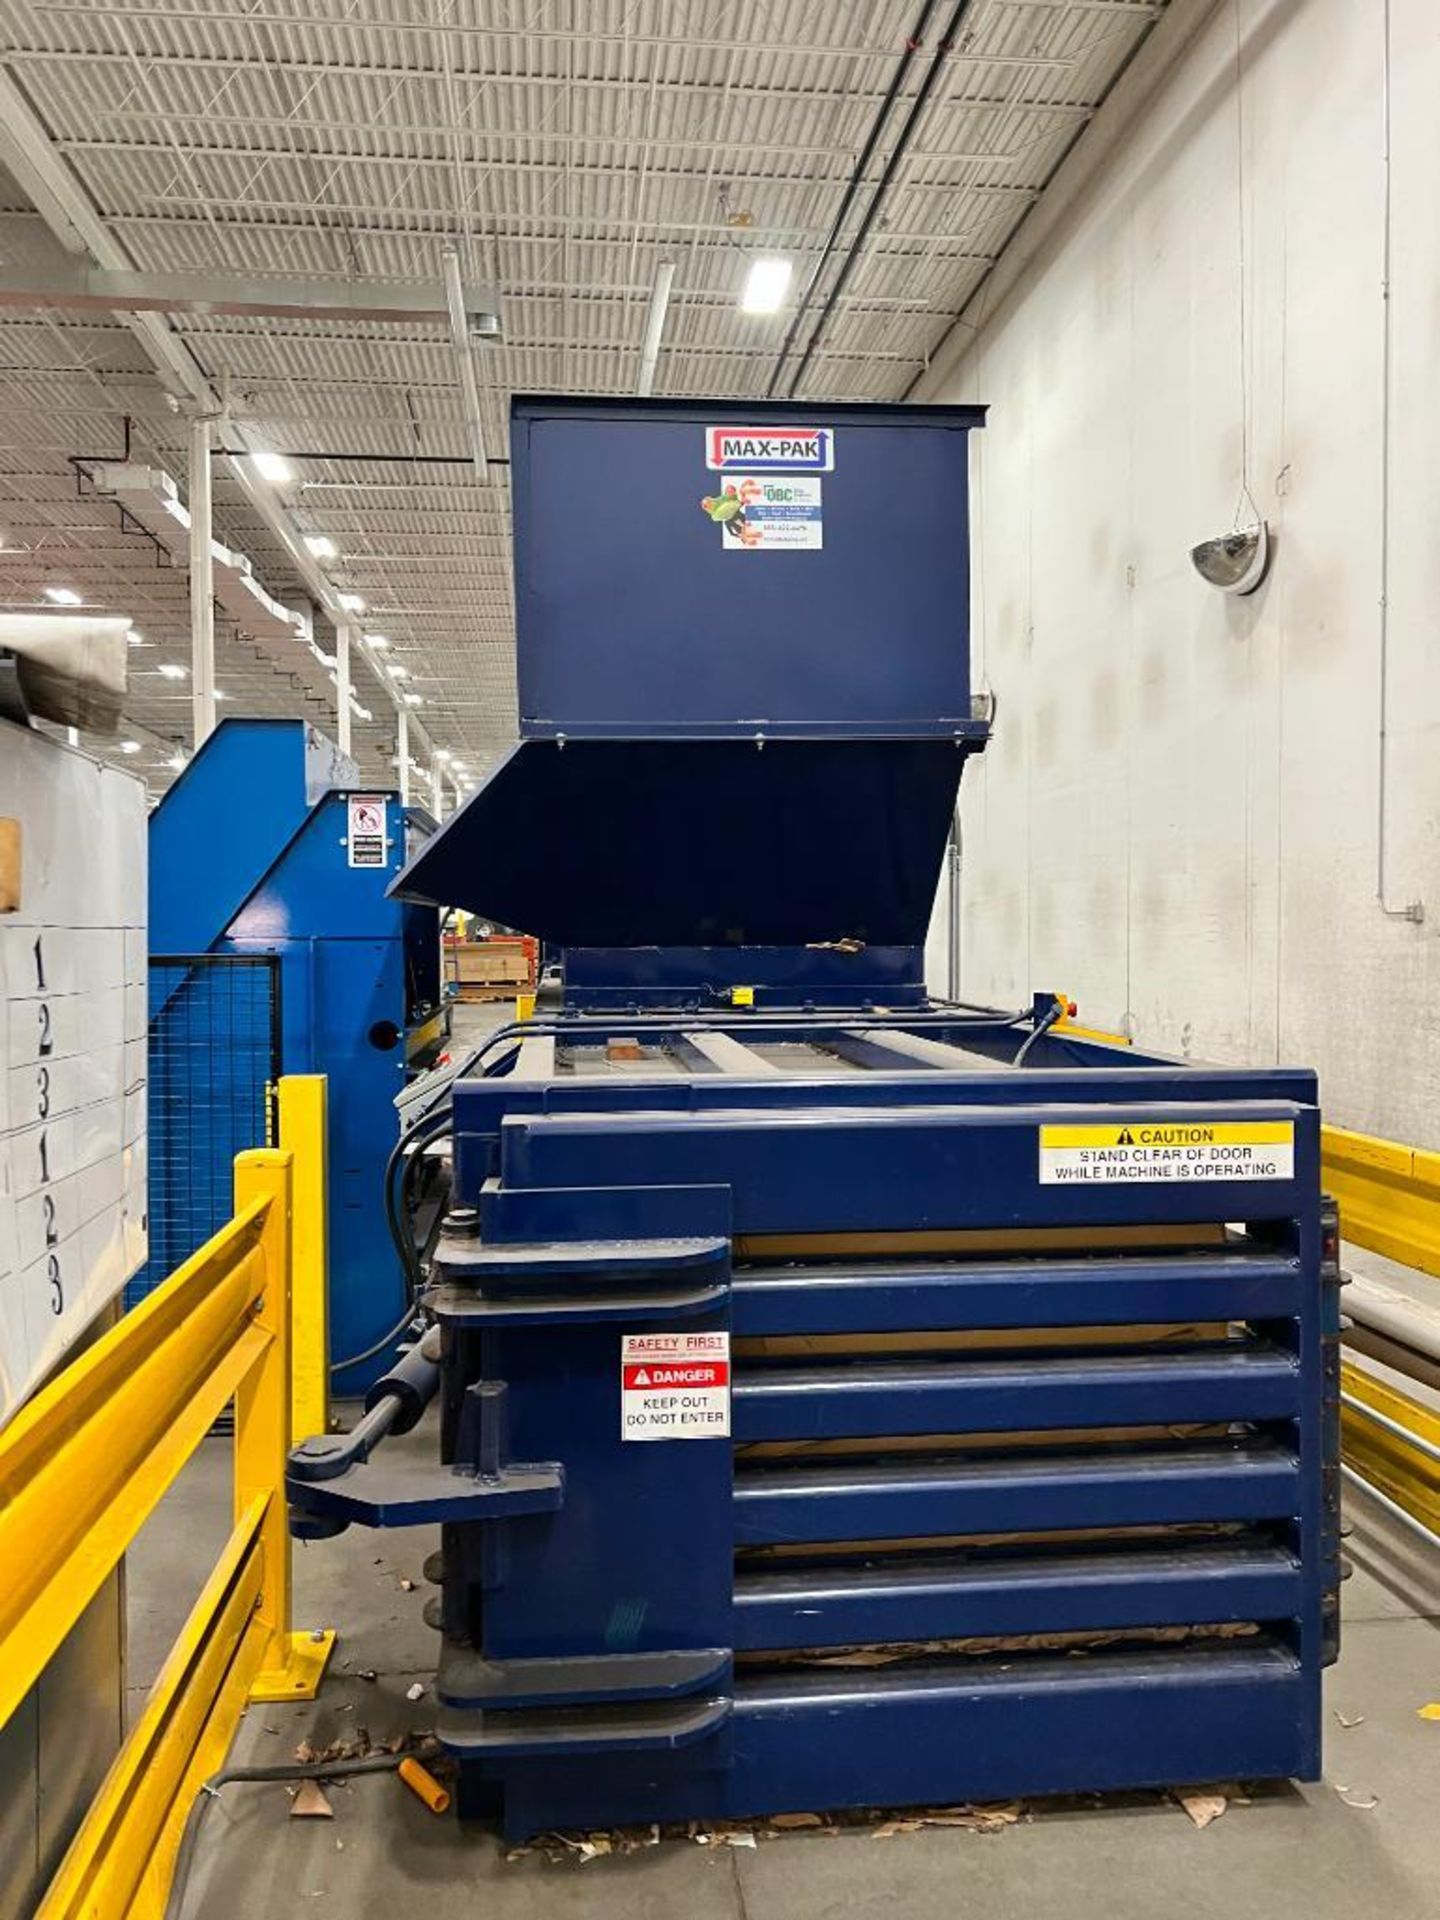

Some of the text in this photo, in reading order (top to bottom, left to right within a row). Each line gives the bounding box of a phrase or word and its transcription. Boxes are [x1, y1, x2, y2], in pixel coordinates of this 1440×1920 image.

[723, 440, 818, 457] MAX-PAK
[34, 934, 46, 991] 1
[38, 1003, 52, 1056] 2
[38, 1067, 50, 1120] 3
[1140, 1129, 1214, 1144] CAUTION
[39, 1128, 50, 1183] 1
[1079, 1147, 1252, 1162] STAND CLEAR OF DOOR
[1055, 1163, 1276, 1179] WHILE MACHINE IS OPERATING
[44, 1194, 57, 1249] 2
[48, 1255, 63, 1316] 3
[628, 1337, 724, 1348] SAFETY FIRST
[653, 1369, 715, 1383] DANGER
[643, 1397, 708, 1409] KEEP OUT
[627, 1412, 724, 1425] DO NOT ENTER
